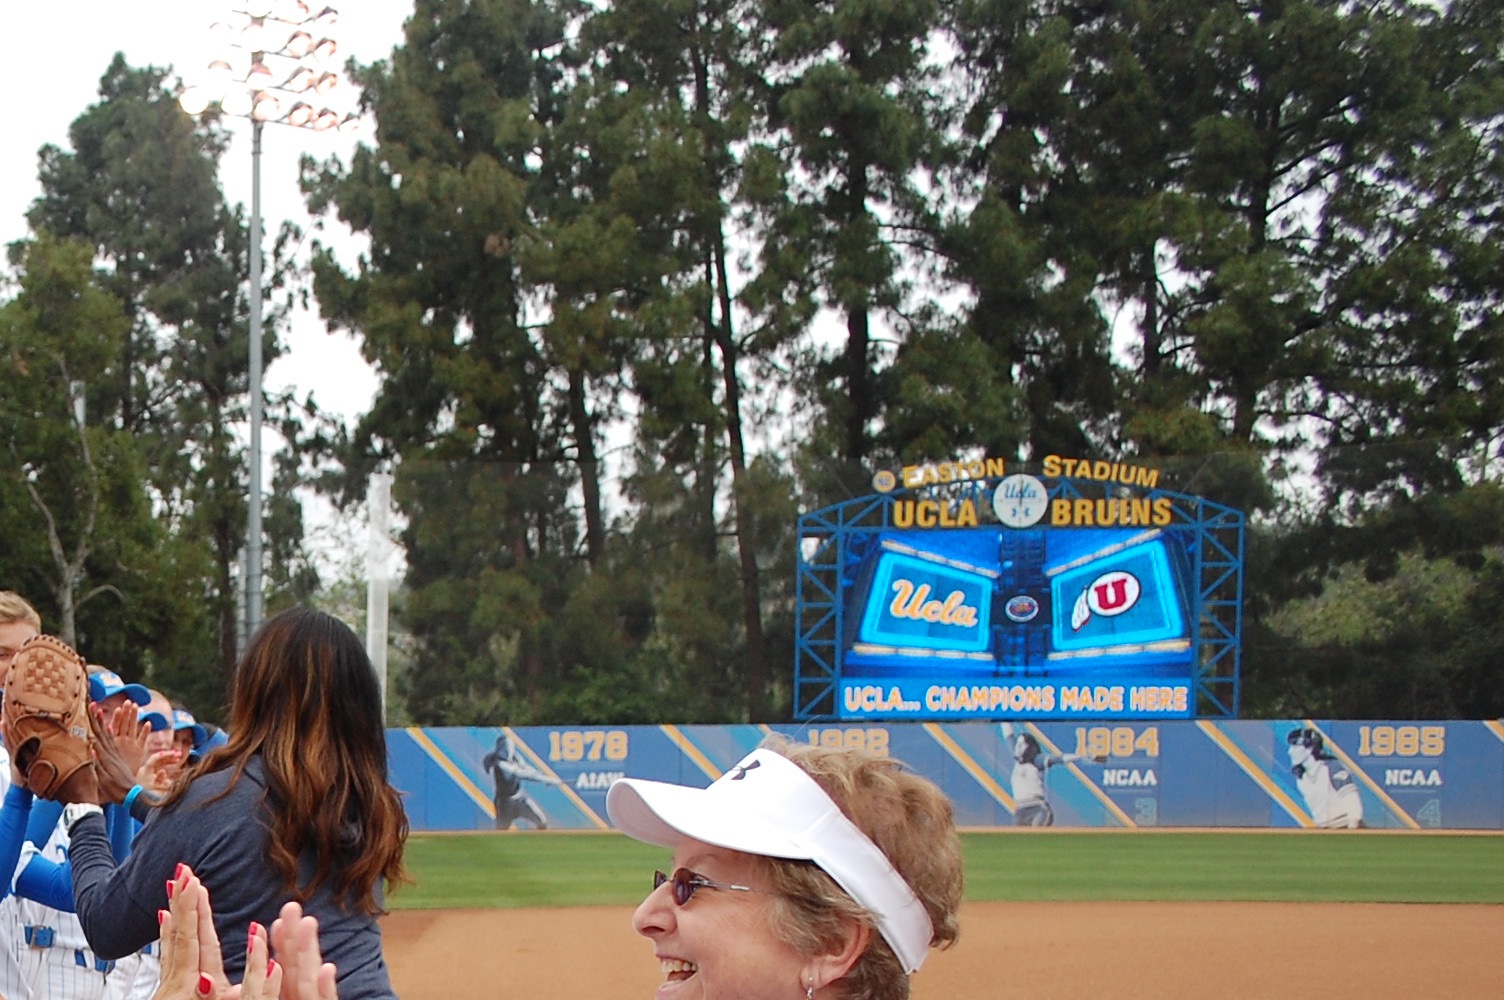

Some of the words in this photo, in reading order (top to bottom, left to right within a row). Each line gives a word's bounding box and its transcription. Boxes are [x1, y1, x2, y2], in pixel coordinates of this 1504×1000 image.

[903, 457, 1005, 488] EASTON
[1042, 455, 1159, 488] STADIUM
[894, 500, 978, 527] UCLA
[1051, 497, 1172, 526] BRUINS
[892, 578, 978, 627] Ucla
[1094, 578, 1127, 610] U
[925, 685, 1056, 712] CHAMPIONS
[1060, 686, 1124, 712] MADE
[1130, 686, 1188, 713] HERE
[549, 730, 628, 761] 1978
[1076, 727, 1159, 757] 1984
[1358, 725, 1445, 757] 1985
[1103, 769, 1157, 786] NCAA
[1385, 769, 1442, 786] NCAA
[1416, 798, 1441, 827] 4
